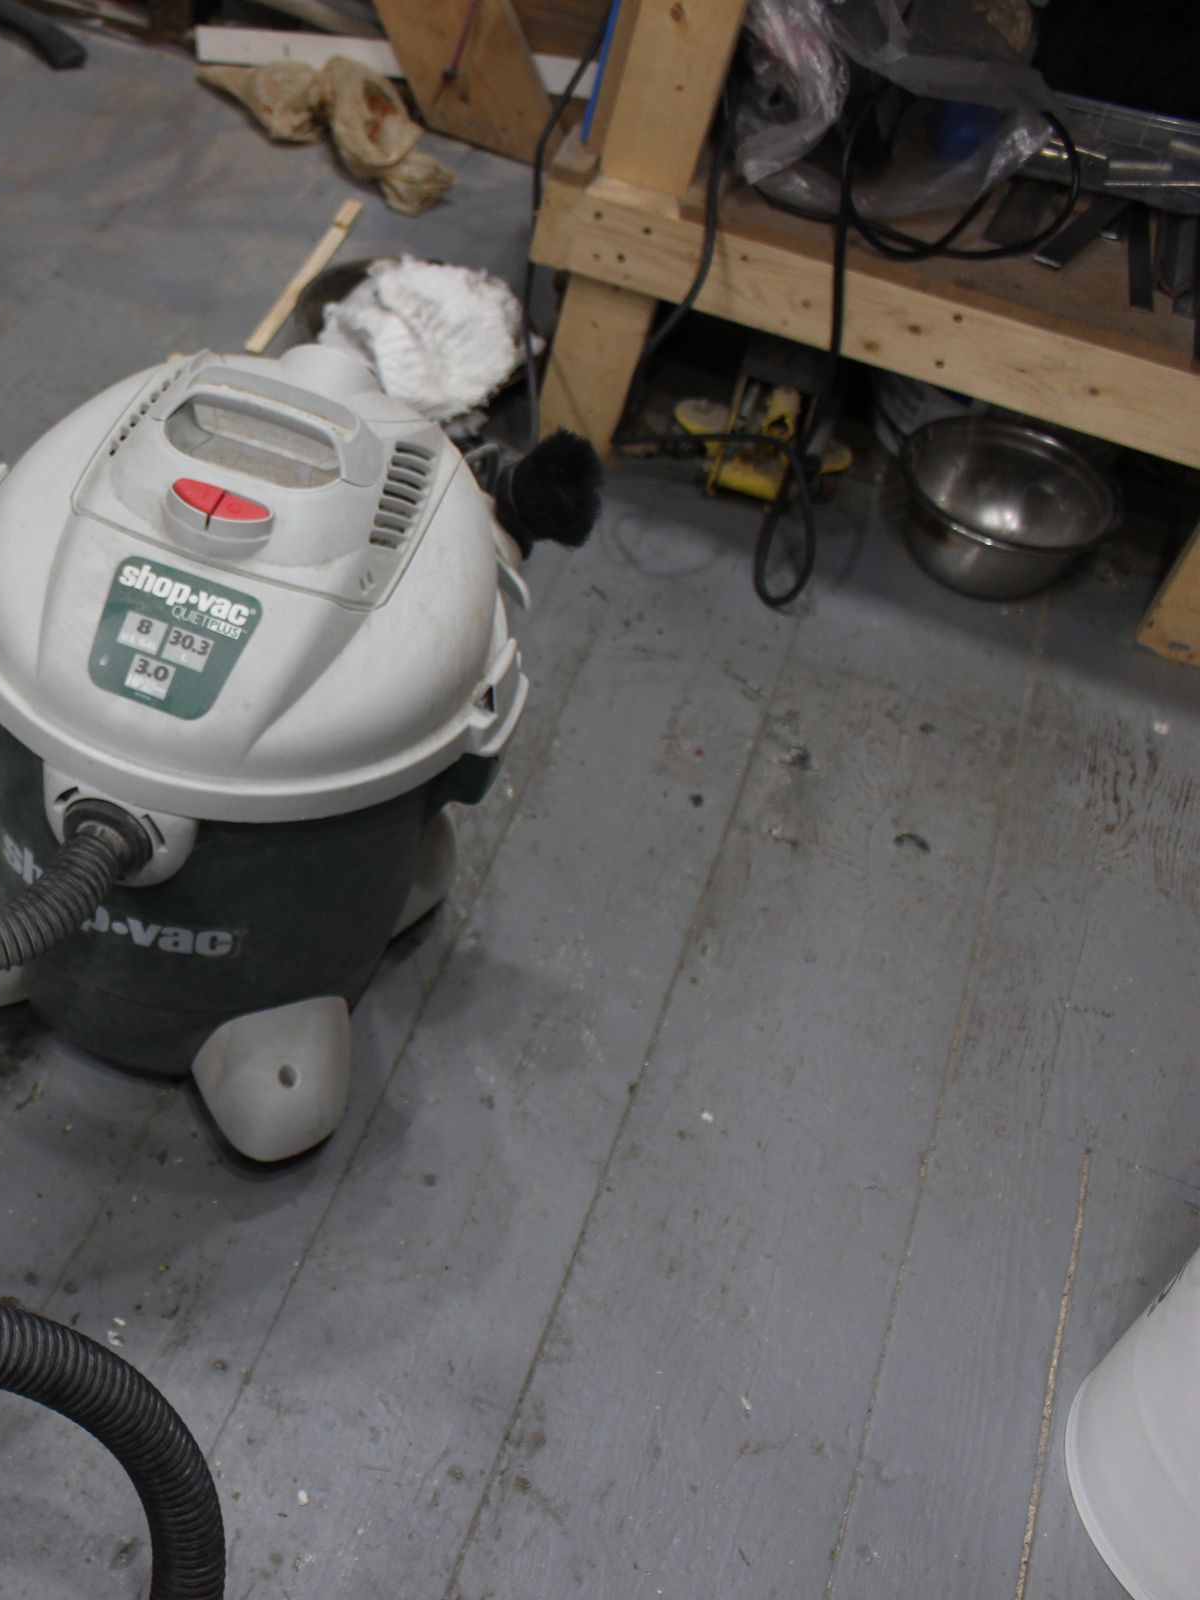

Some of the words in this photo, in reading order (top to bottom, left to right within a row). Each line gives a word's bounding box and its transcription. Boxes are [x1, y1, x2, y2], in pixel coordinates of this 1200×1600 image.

[137, 619, 153, 635] 8
[169, 630, 211, 656] 30.3
[134, 658, 170, 682] 3.0
